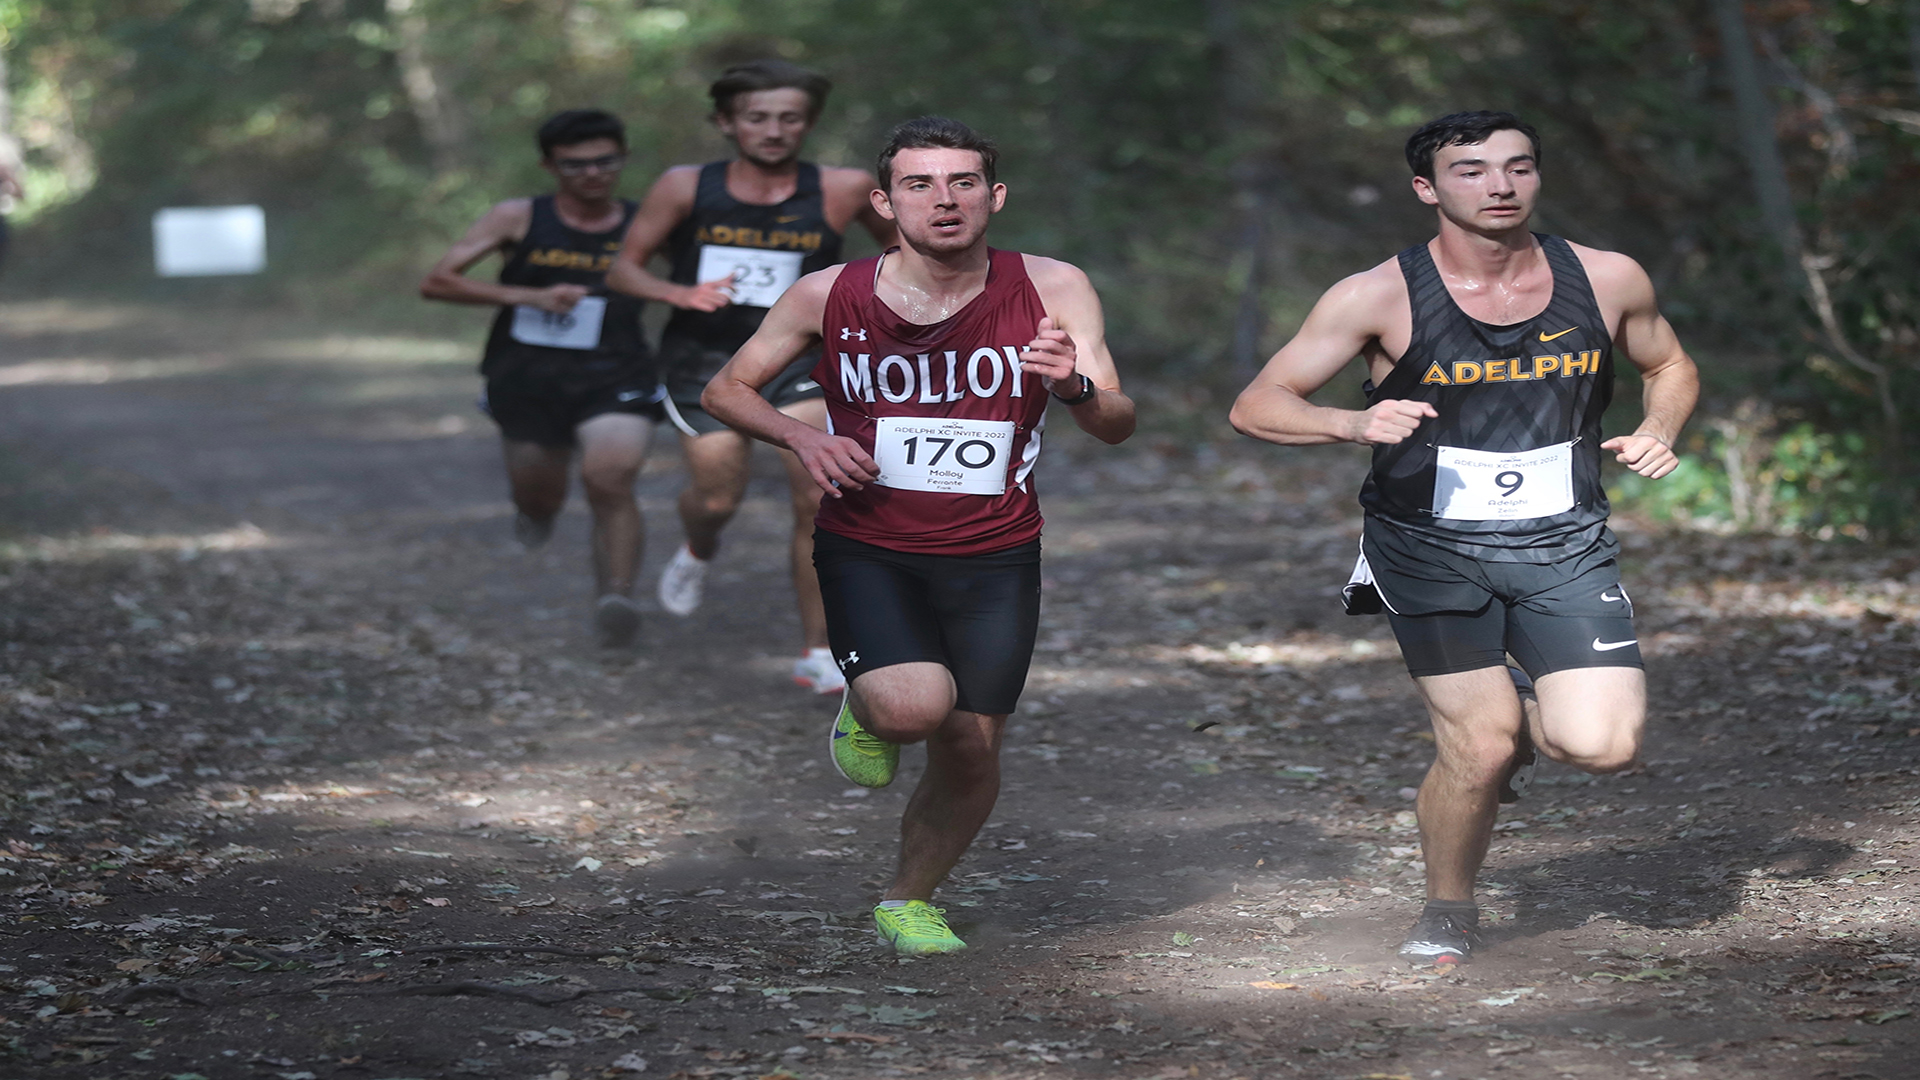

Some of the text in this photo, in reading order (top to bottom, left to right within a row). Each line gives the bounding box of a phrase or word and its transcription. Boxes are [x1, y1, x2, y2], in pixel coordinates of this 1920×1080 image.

[696, 224, 822, 249] ADELPHI
[734, 264, 776, 287] 23
[838, 346, 1031, 403] MOLLOY
[1420, 349, 1602, 386] ADELPHI
[894, 427, 936, 435] ADELPHI
[953, 430, 982, 438] INVITE
[985, 431, 1006, 439] 2022
[903, 436, 996, 469] 170
[1454, 459, 1494, 468] ADELPHI
[1512, 460, 1538, 468] INVITE
[929, 469, 964, 479] Molloy
[1494, 470, 1524, 497] 9
